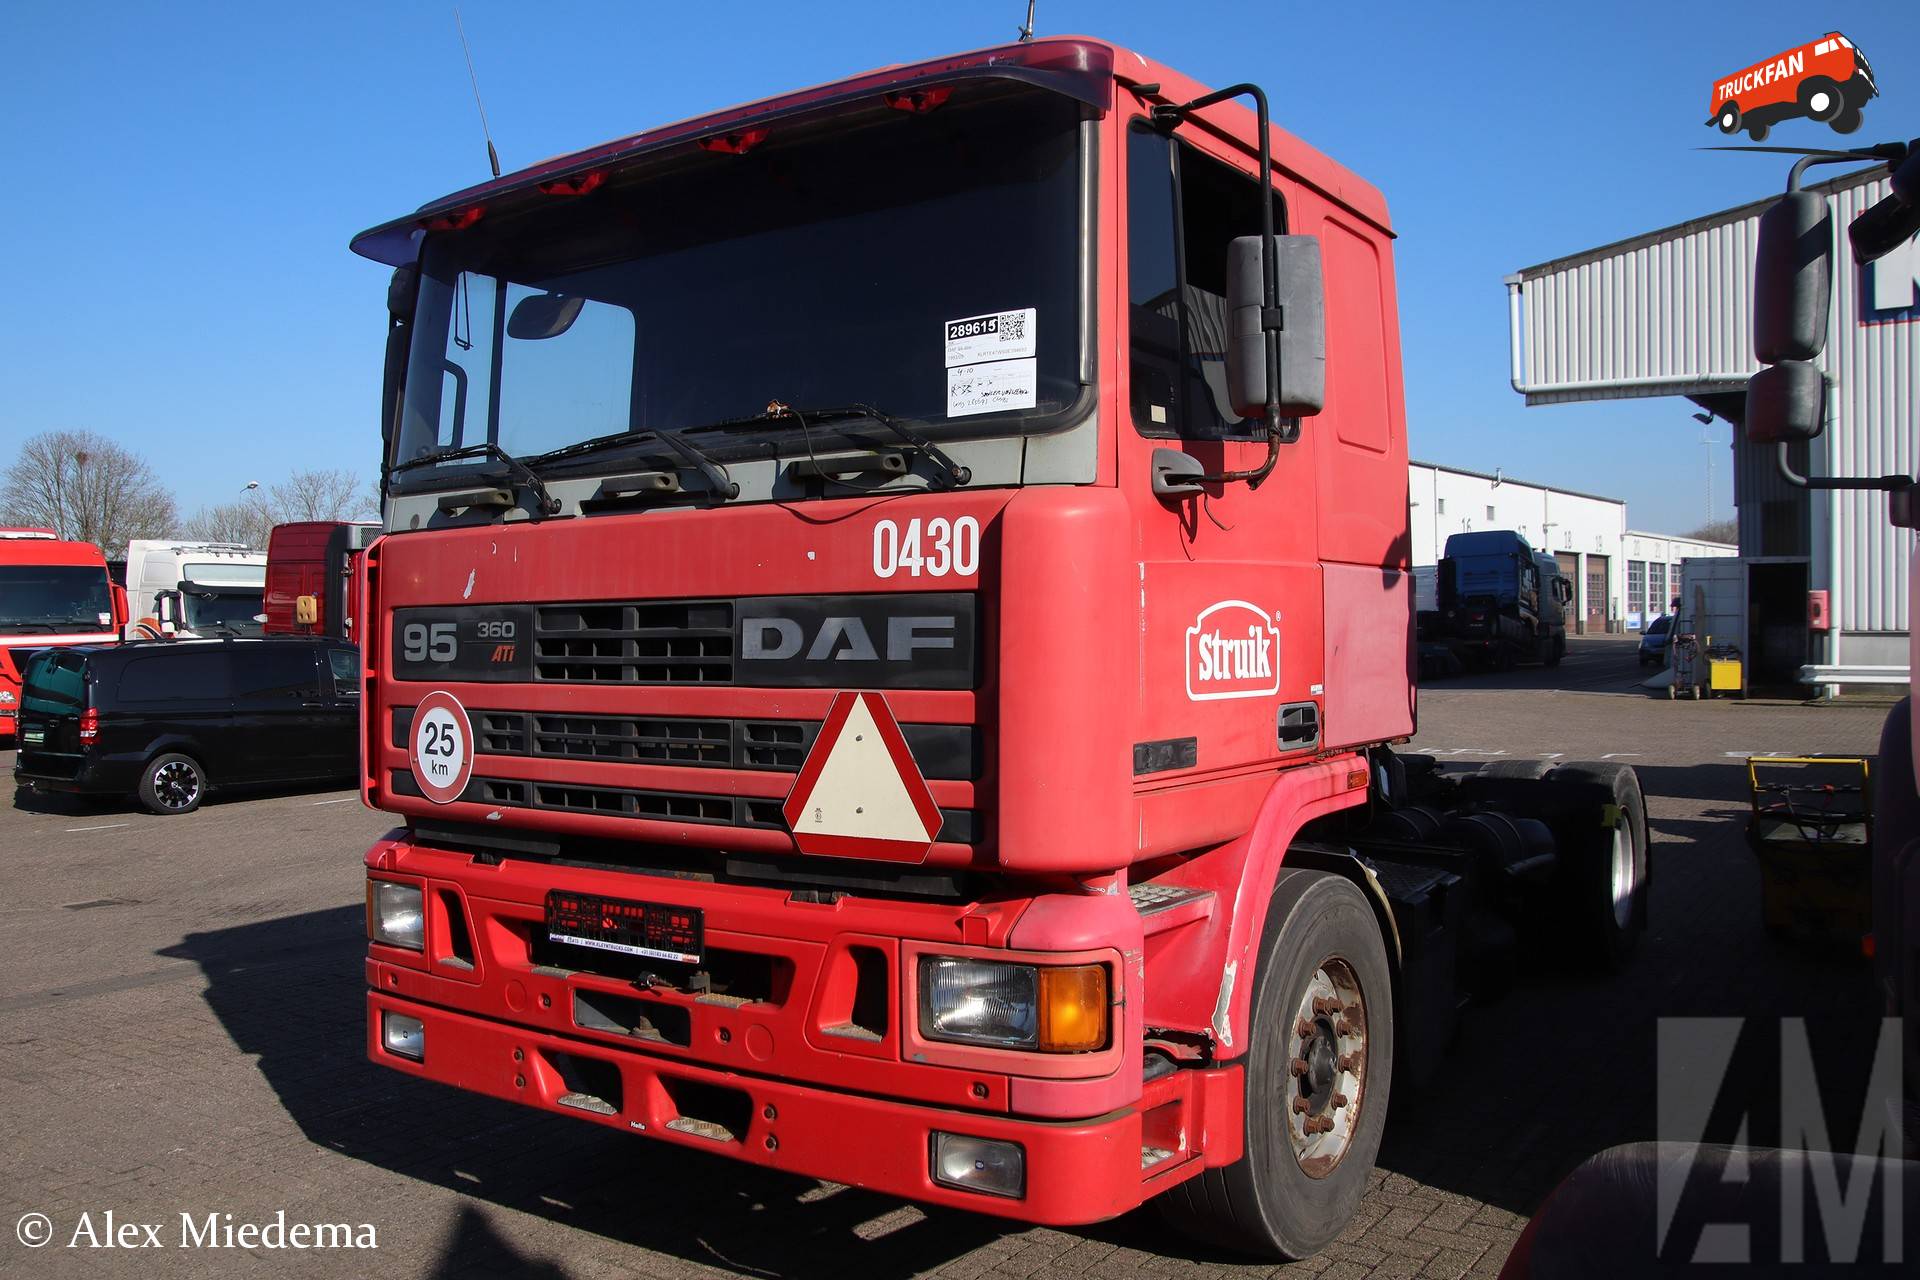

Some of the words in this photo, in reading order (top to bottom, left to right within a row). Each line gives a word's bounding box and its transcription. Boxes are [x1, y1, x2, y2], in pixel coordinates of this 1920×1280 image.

[949, 320, 996, 339] 289615
[873, 515, 980, 578] 0430
[403, 622, 458, 662] 95
[477, 621, 515, 638] 360
[742, 616, 955, 661] DAF
[1198, 625, 1272, 681] Struik
[424, 721, 455, 757] 25
[431, 760, 449, 776] km
